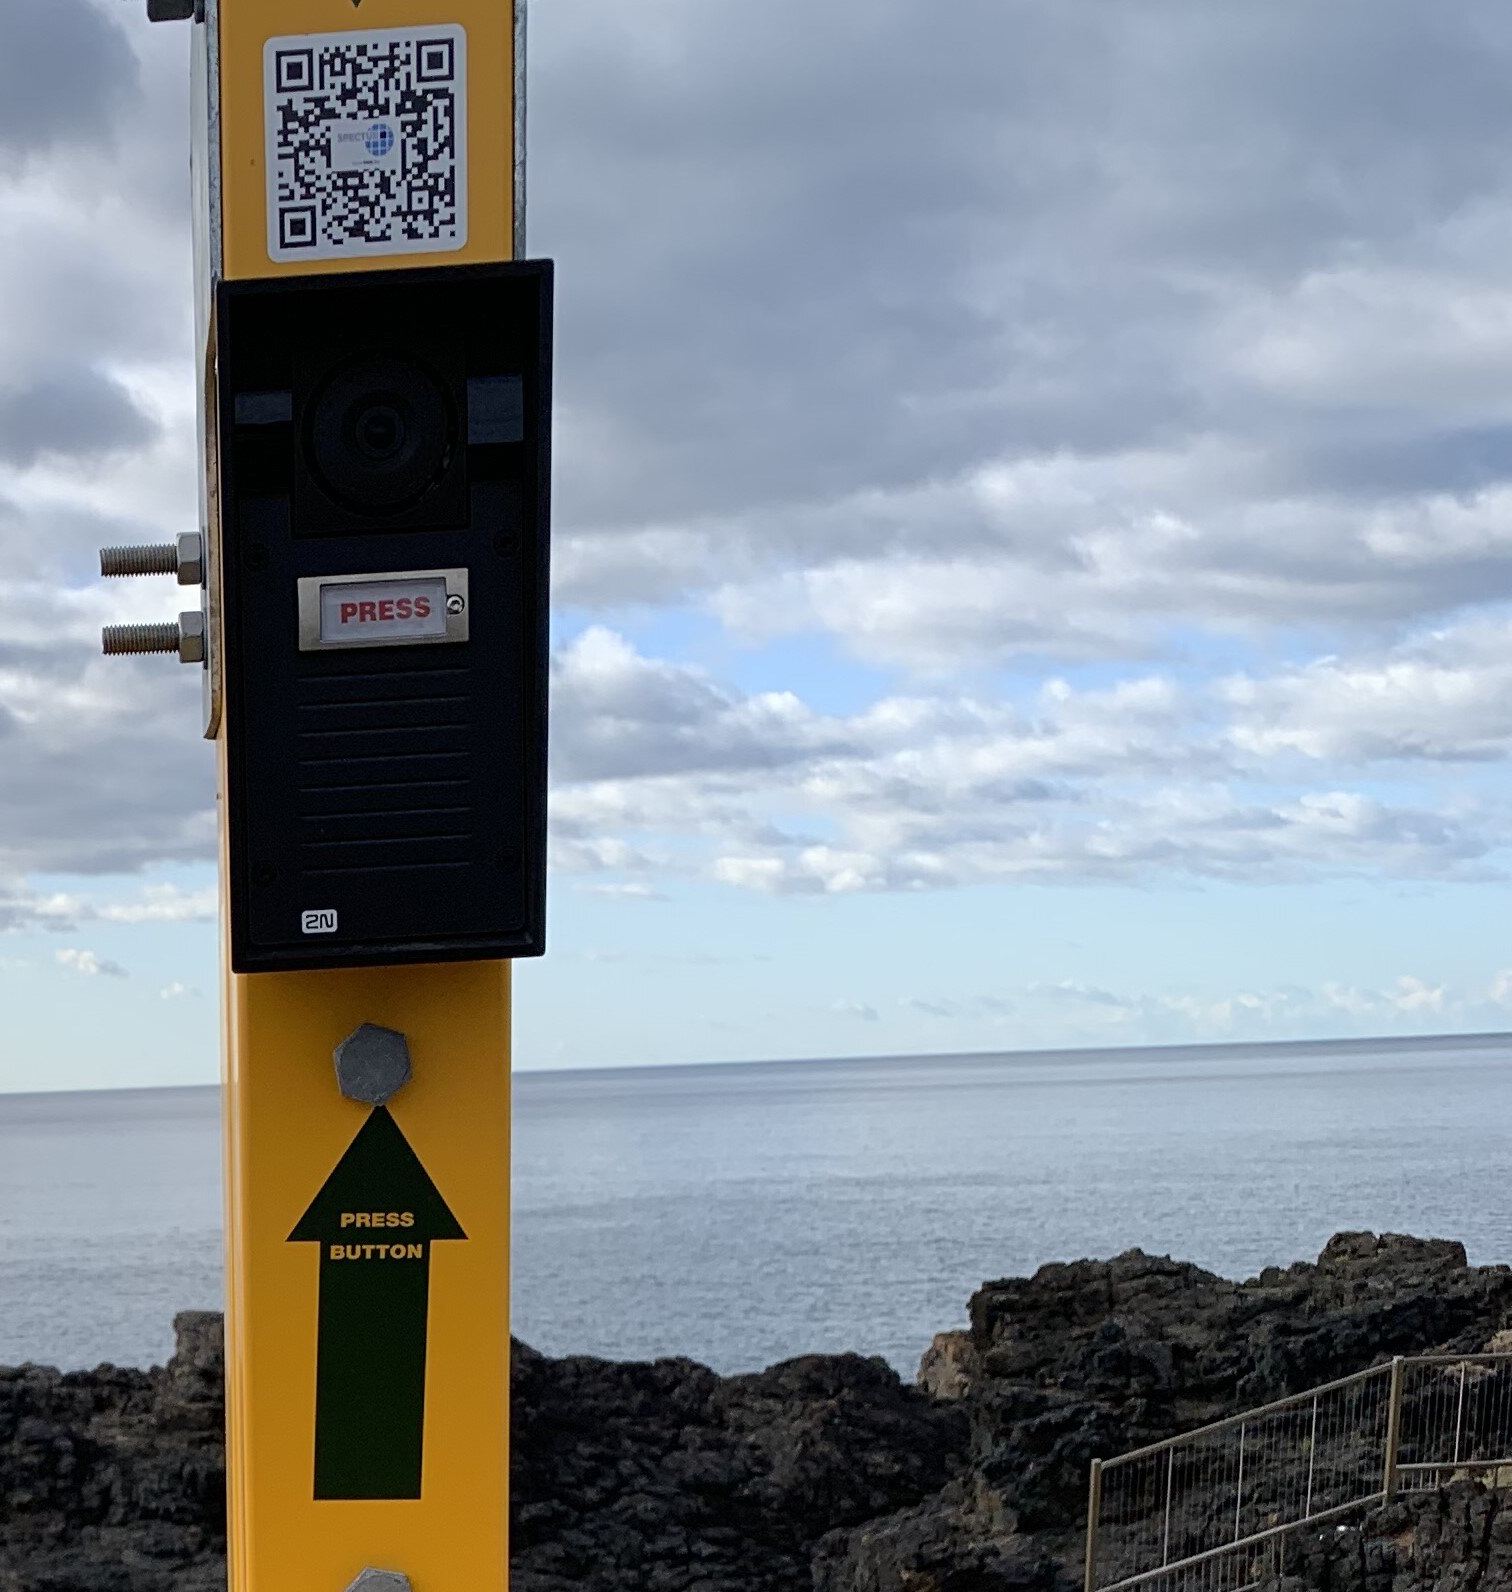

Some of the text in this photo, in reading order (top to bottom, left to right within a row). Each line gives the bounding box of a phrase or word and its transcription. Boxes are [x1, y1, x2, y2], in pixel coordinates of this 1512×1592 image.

[340, 596, 431, 624] PRESS
[305, 912, 334, 930] 2N
[340, 1211, 415, 1229] PRESS
[329, 1243, 423, 1261] BUTTON
